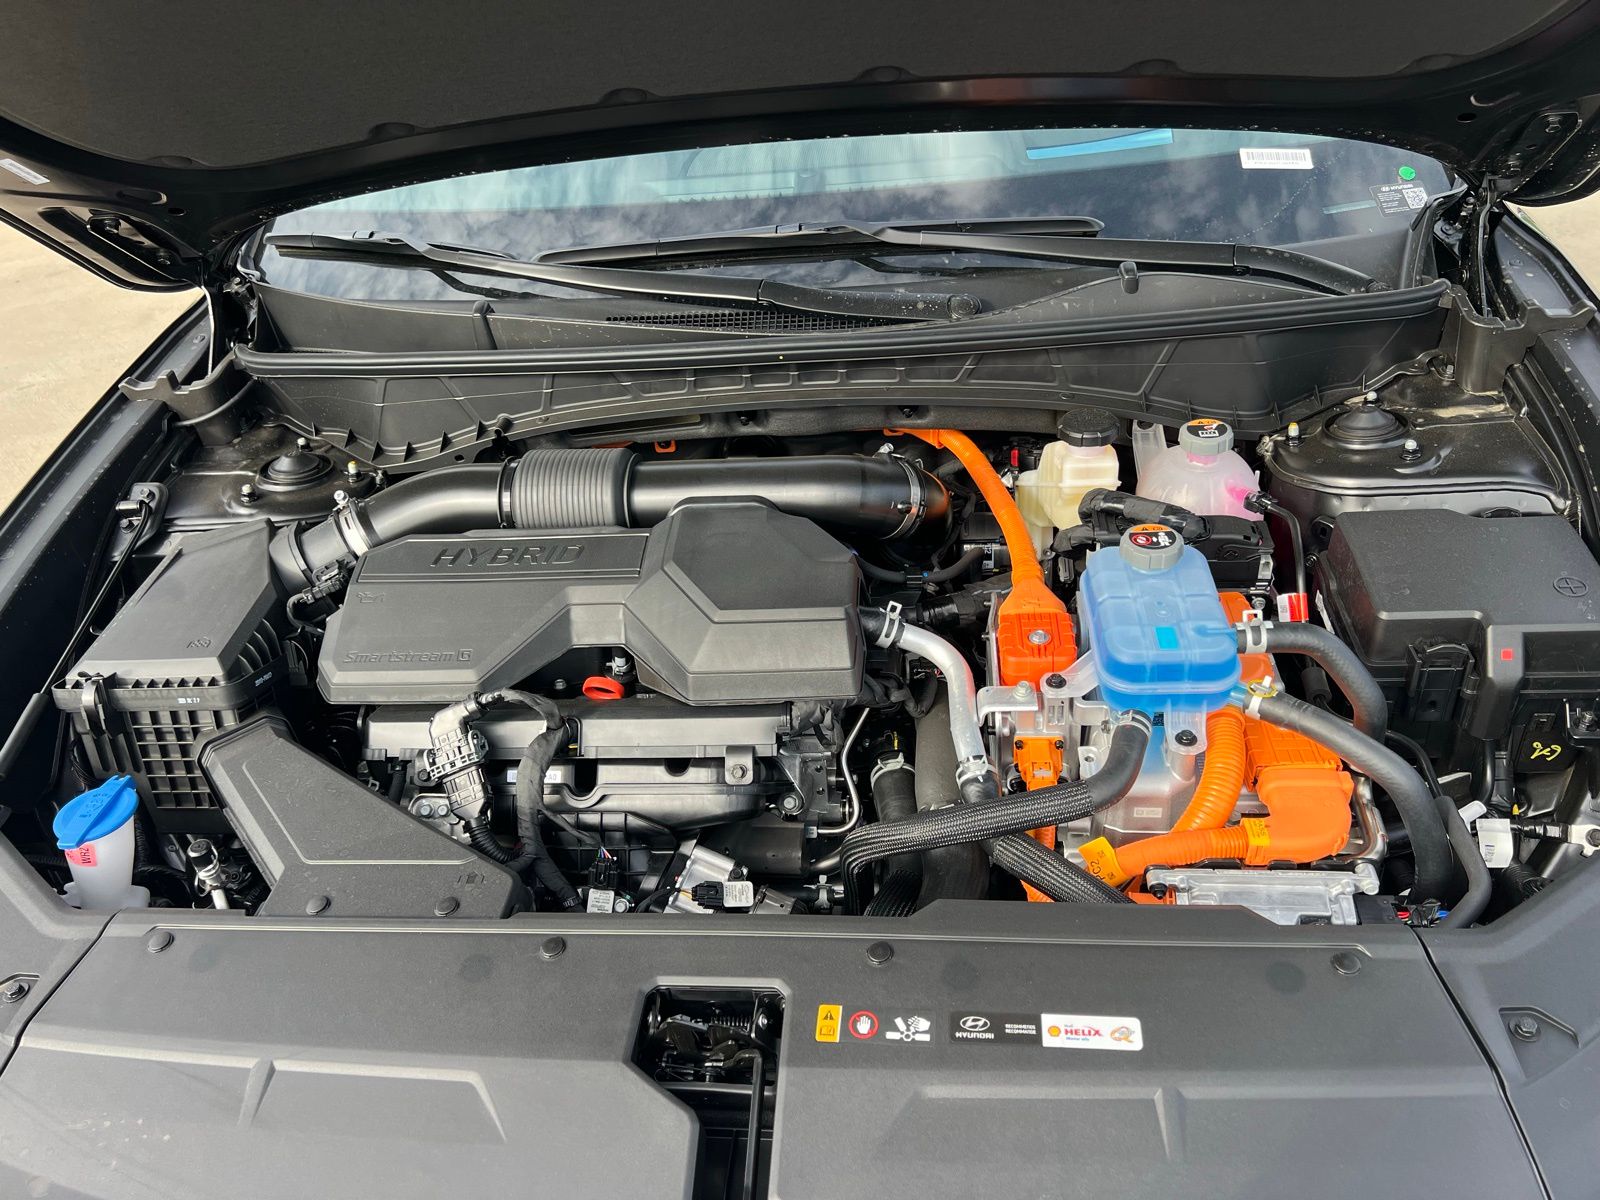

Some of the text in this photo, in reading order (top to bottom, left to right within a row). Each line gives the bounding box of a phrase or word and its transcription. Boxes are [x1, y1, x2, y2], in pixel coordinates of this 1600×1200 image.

[430, 544, 585, 567] HYBRID
[343, 650, 456, 663] Smartstream
[955, 1031, 995, 1039] HYUNDAI
[1064, 1027, 1103, 1037] HELIX
